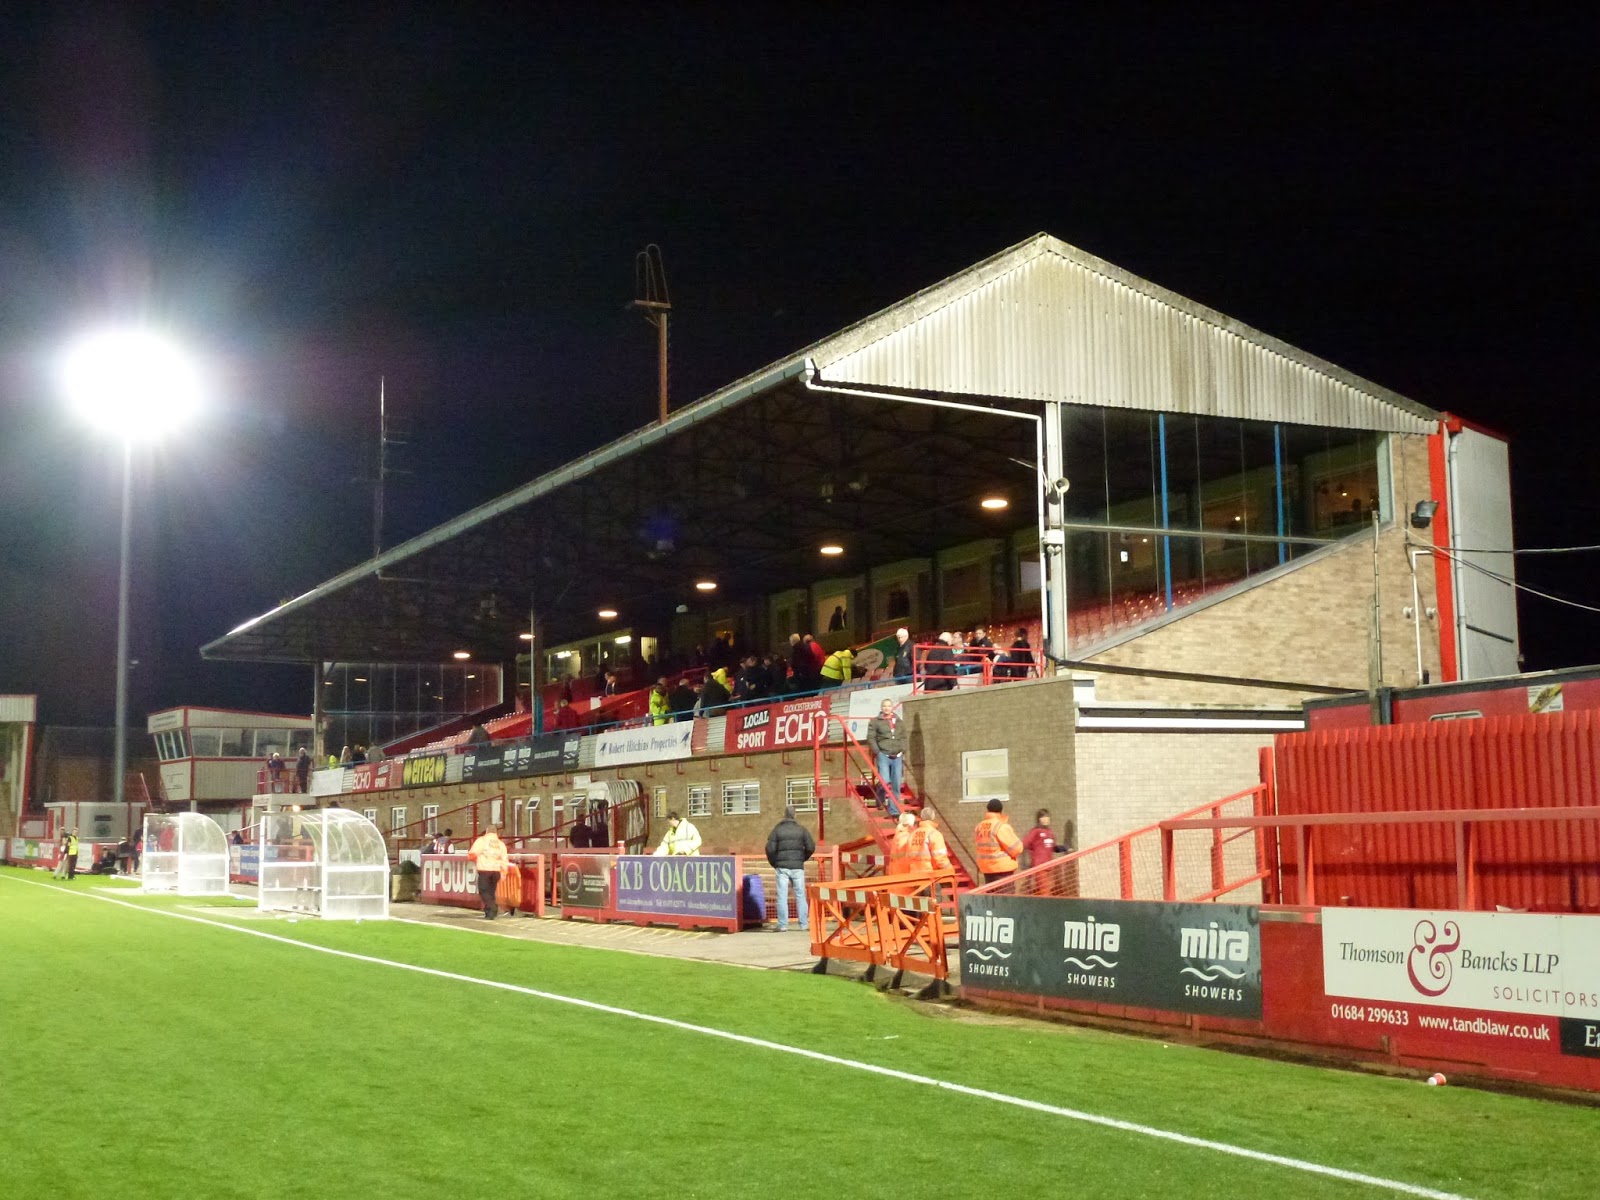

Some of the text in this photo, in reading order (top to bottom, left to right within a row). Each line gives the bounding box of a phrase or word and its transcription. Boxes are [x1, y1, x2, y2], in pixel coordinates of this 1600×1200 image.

[743, 710, 769, 729] LOCAL
[774, 710, 828, 744] ECHO
[737, 731, 766, 749] SPORT
[649, 861, 732, 894] COACHES
[965, 910, 1014, 944] mira
[1063, 915, 1120, 952] mira
[1180, 921, 1250, 962] mira
[968, 962, 1010, 977] SHOWERS
[1339, 942, 1404, 965] Thomson
[1460, 949, 1518, 972] Bancks
[1522, 952, 1560, 974] LLP
[1067, 972, 1116, 988] SHOWERS
[1184, 983, 1243, 1002] SHOWERS
[1493, 986, 1598, 1008] SOLICITORS
[1331, 1003, 1551, 1041] 01684 299633 www.tandblaw.co.uk
